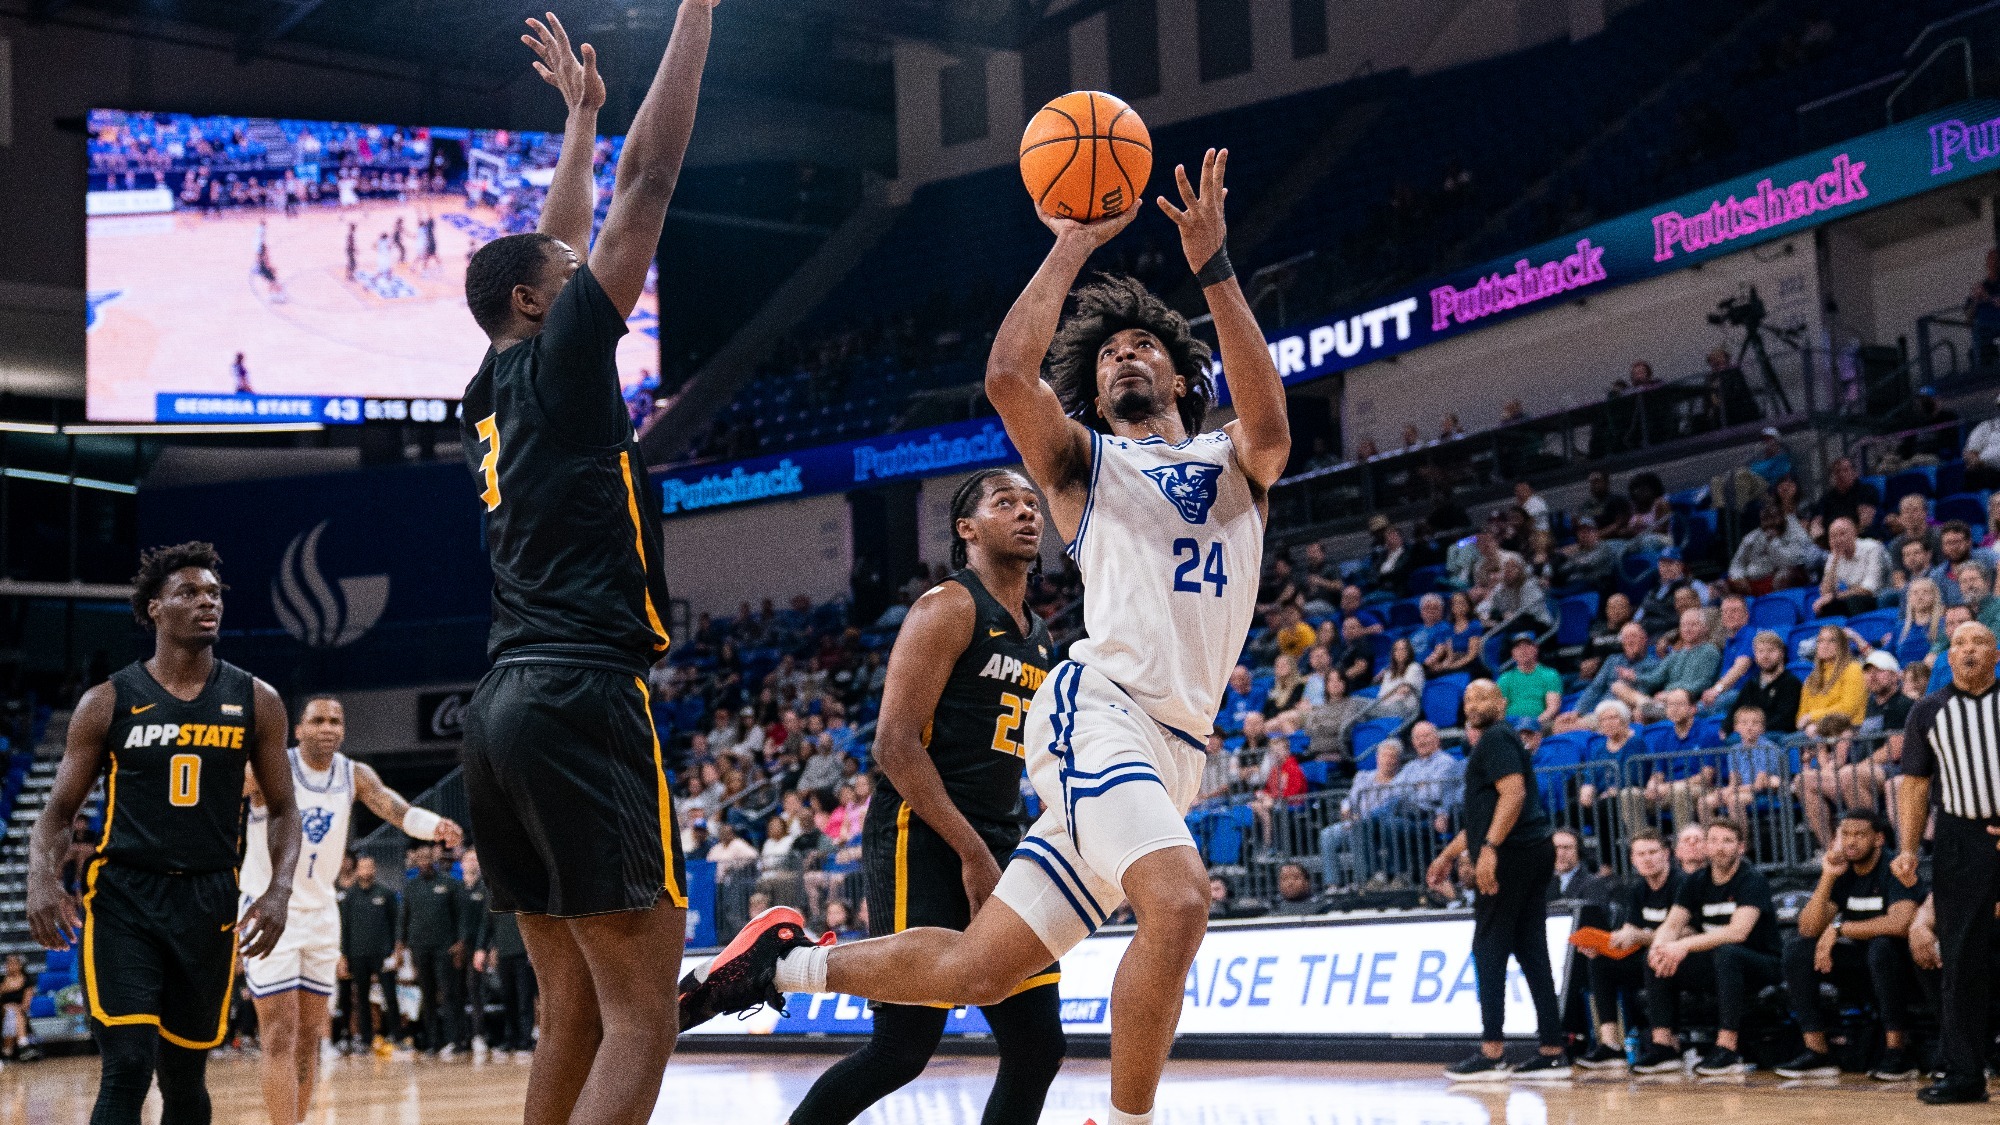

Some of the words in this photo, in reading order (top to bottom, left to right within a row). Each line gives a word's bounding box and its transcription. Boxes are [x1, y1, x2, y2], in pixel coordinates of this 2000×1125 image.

[1652, 154, 1869, 263] Puttshack
[1429, 239, 1607, 332] Puttshack
[1310, 297, 1418, 368] PUTT
[174, 397, 254, 415] GEORGIA
[256, 399, 312, 416] STATE
[323, 398, 360, 421] 43
[475, 412, 502, 513] 3
[854, 423, 1008, 482] Puttshack
[662, 458, 803, 514] Puttshack
[1173, 538, 1228, 598] 24
[124, 723, 246, 750] APPSTATE
[991, 692, 1032, 760] 2
[169, 754, 202, 807] 0
[307, 853, 317, 878] 1
[1184, 956, 1279, 1008] AISE
[1300, 952, 1398, 1006] THE
[1060, 1001, 1100, 1020] IGHT
